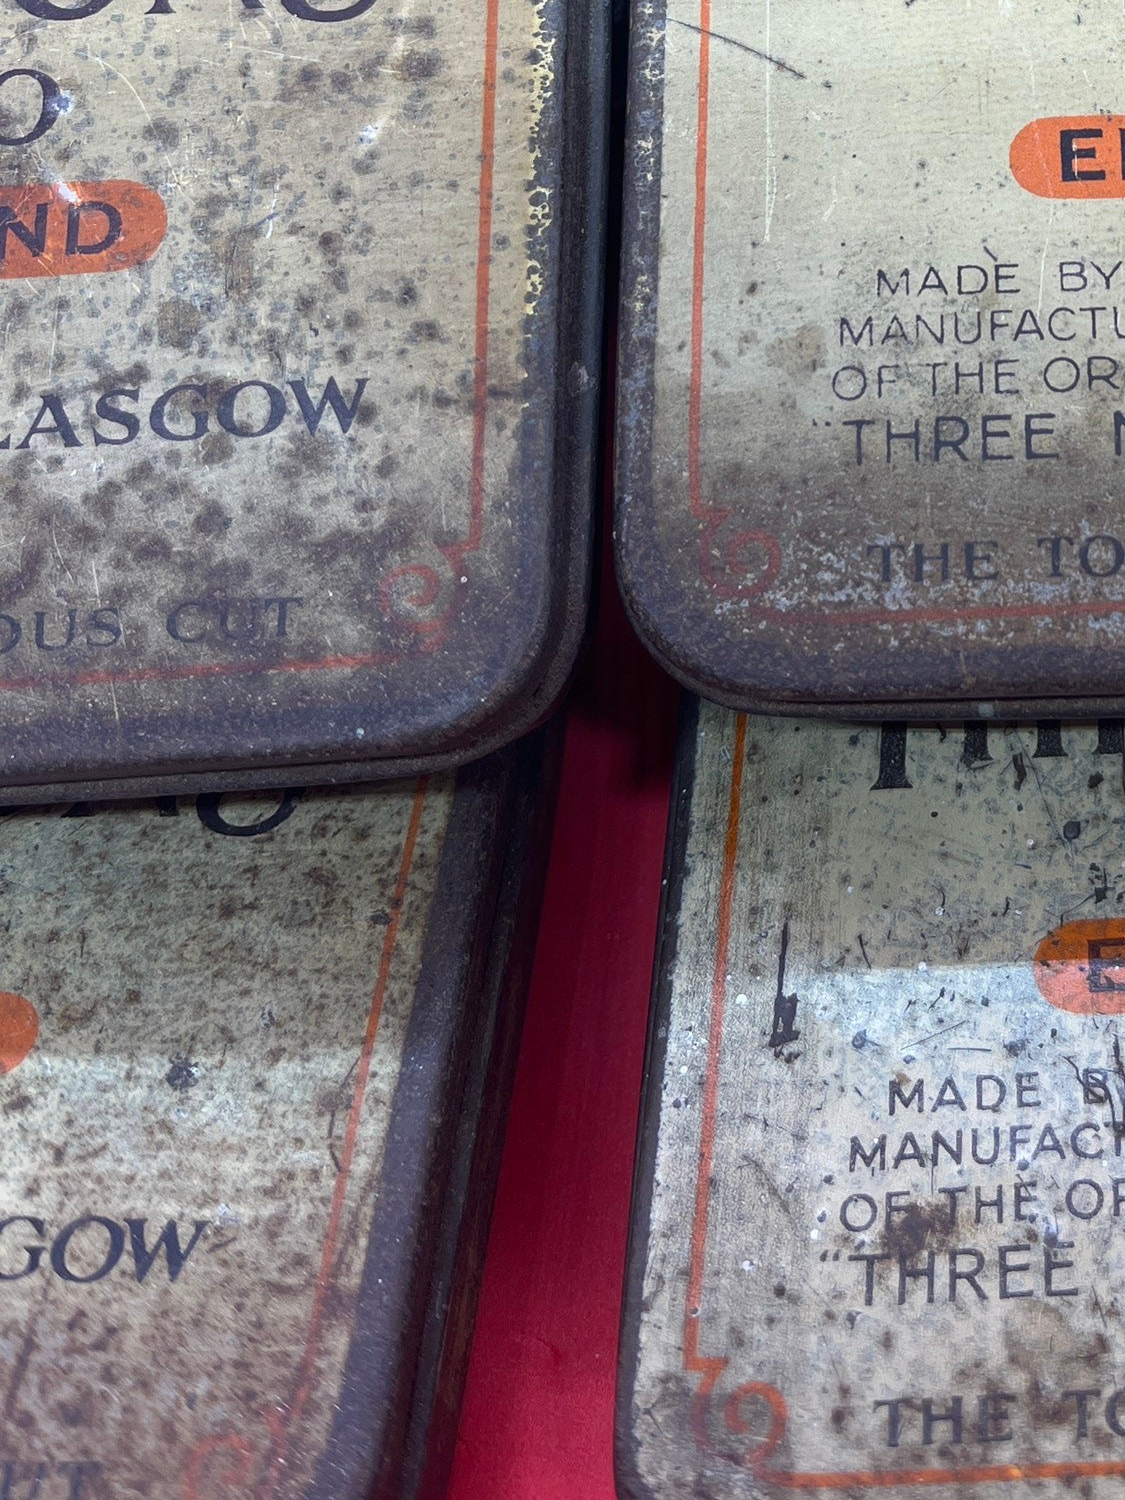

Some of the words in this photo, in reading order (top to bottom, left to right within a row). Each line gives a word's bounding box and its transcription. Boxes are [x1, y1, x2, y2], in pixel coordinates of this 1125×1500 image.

[876, 263, 1021, 298] MADE
[1058, 260, 1124, 292] BY
[831, 363, 899, 402] OF
[921, 357, 1021, 396] THE
[866, 540, 1000, 584] THE
[165, 596, 302, 645] CUT
[887, 1070, 1042, 1116] MADE
[839, 1189, 912, 1233] OF
[938, 1179, 1038, 1226] THE
[873, 1393, 1014, 1448] THE
